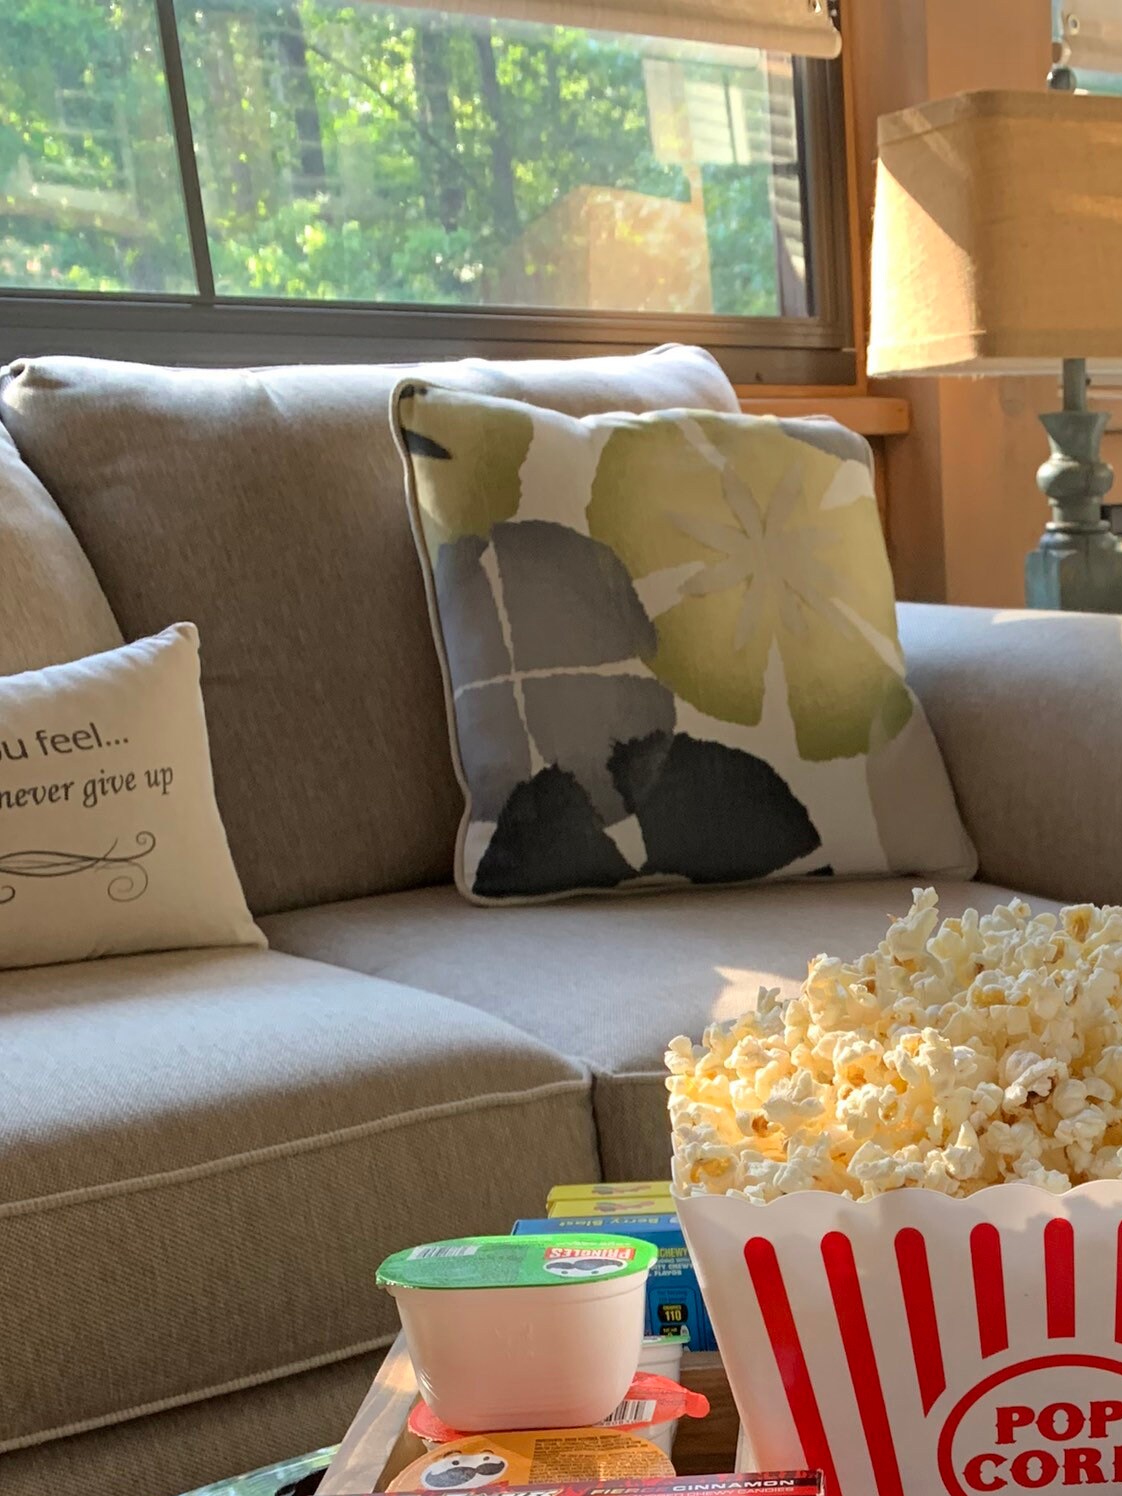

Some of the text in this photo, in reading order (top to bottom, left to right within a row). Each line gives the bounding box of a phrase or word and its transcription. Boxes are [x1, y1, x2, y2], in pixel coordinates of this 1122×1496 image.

[0, 722, 129, 760] u feel...
[83, 769, 136, 808] give
[144, 766, 174, 795] up
[559, 1217, 660, 1227] Berry Blast
[550, 1247, 632, 1259] PRINGLES
[664, 1310, 682, 1321] 110
[590, 1478, 795, 1496] FIERCE CINNAMON
[738, 1486, 795, 1496] CANDIES
